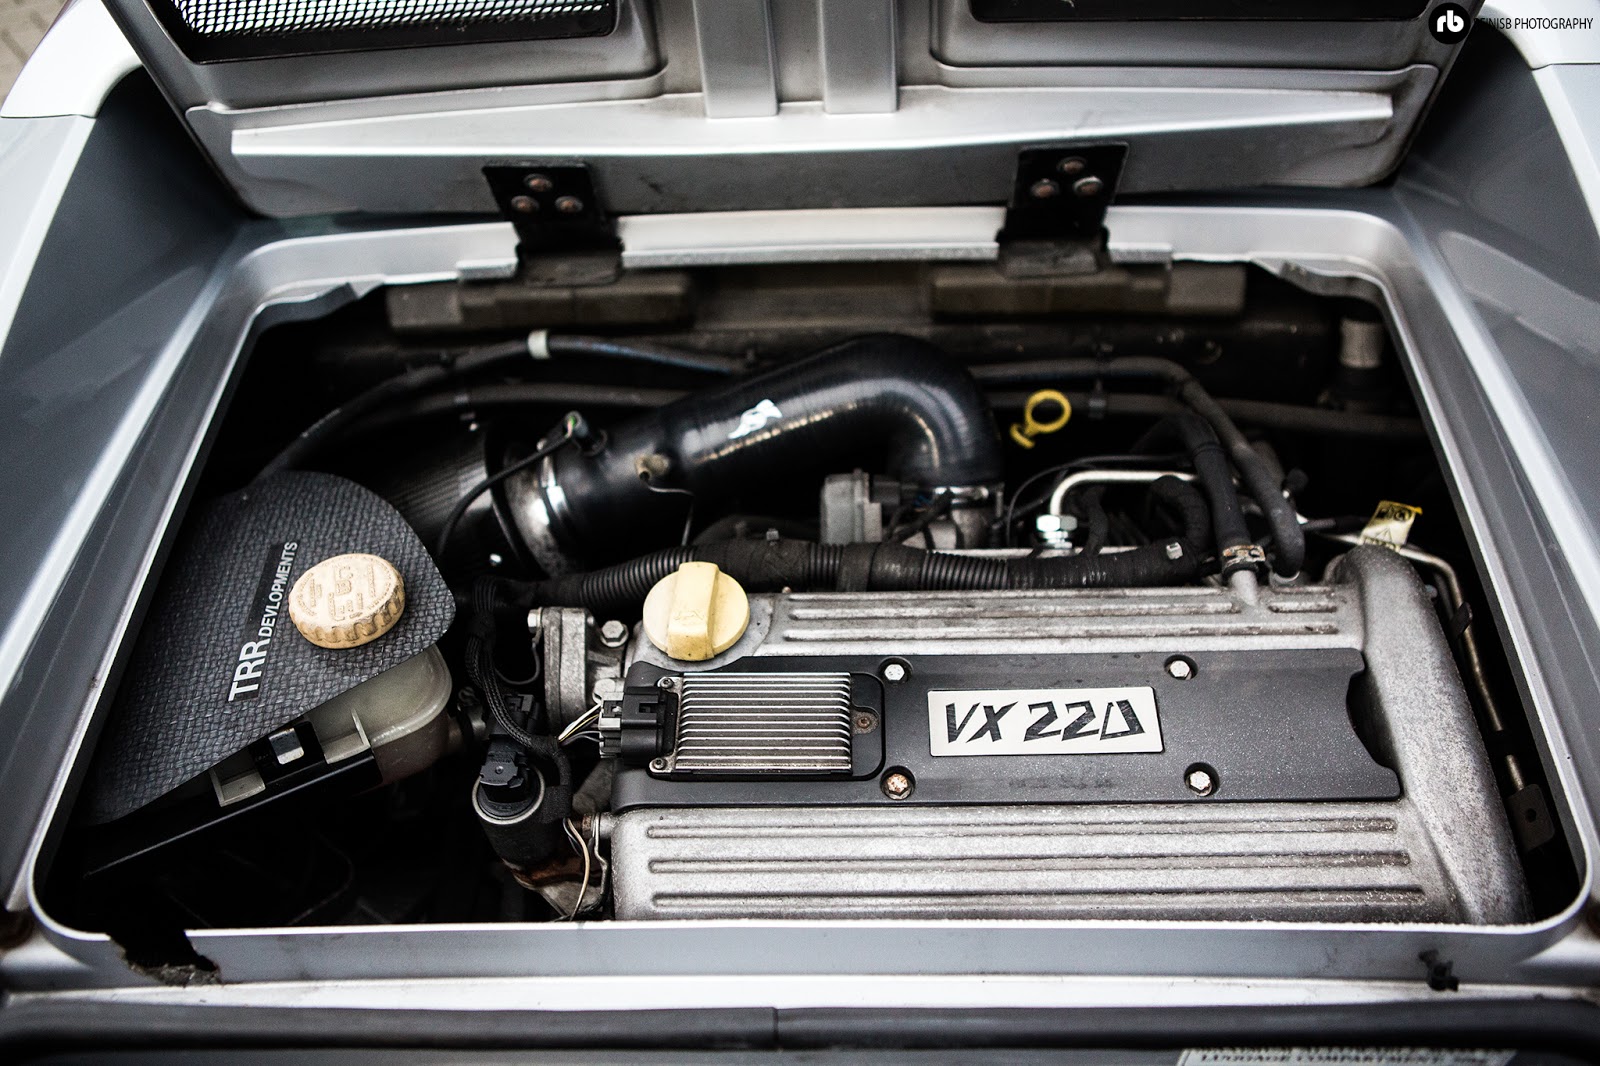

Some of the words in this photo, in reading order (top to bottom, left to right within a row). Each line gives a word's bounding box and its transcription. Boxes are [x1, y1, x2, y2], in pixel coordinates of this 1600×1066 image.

[228, 640, 271, 702] TRR
[258, 541, 299, 639] DEVLOPMENTS
[945, 701, 1018, 744] VX
